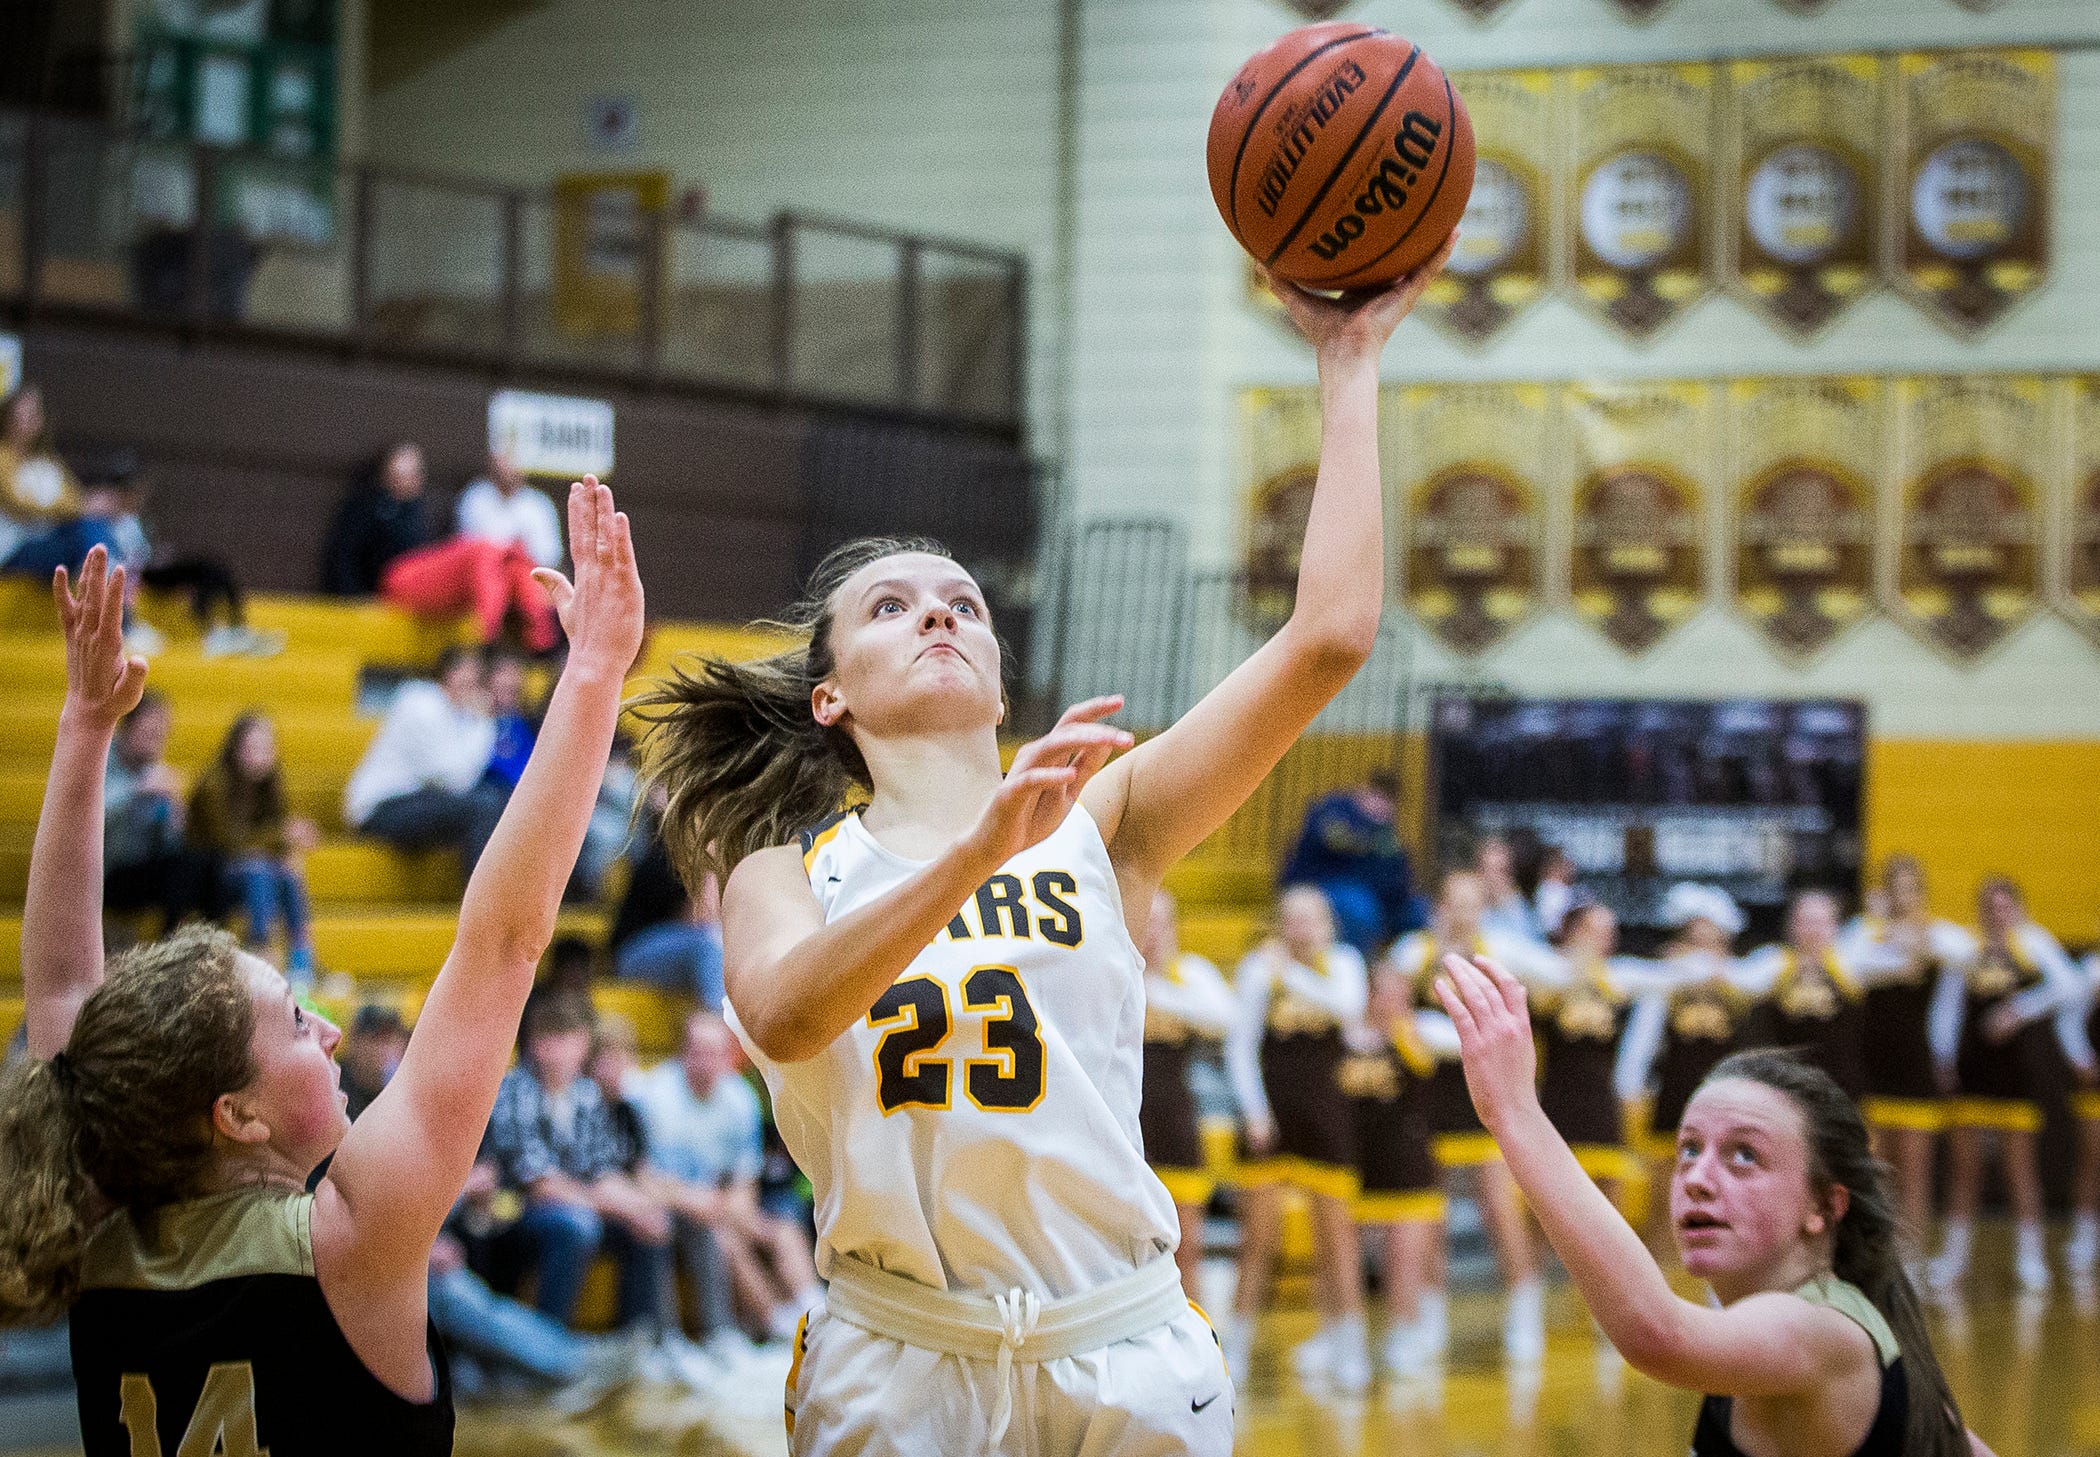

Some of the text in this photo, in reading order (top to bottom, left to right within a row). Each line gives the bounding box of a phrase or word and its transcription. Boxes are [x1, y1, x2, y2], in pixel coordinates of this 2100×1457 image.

[1257, 62, 1366, 217] EVOLUTION
[1306, 109, 1443, 261] Wilson
[866, 963, 1047, 1118] 23
[118, 1360, 271, 1457] 14
